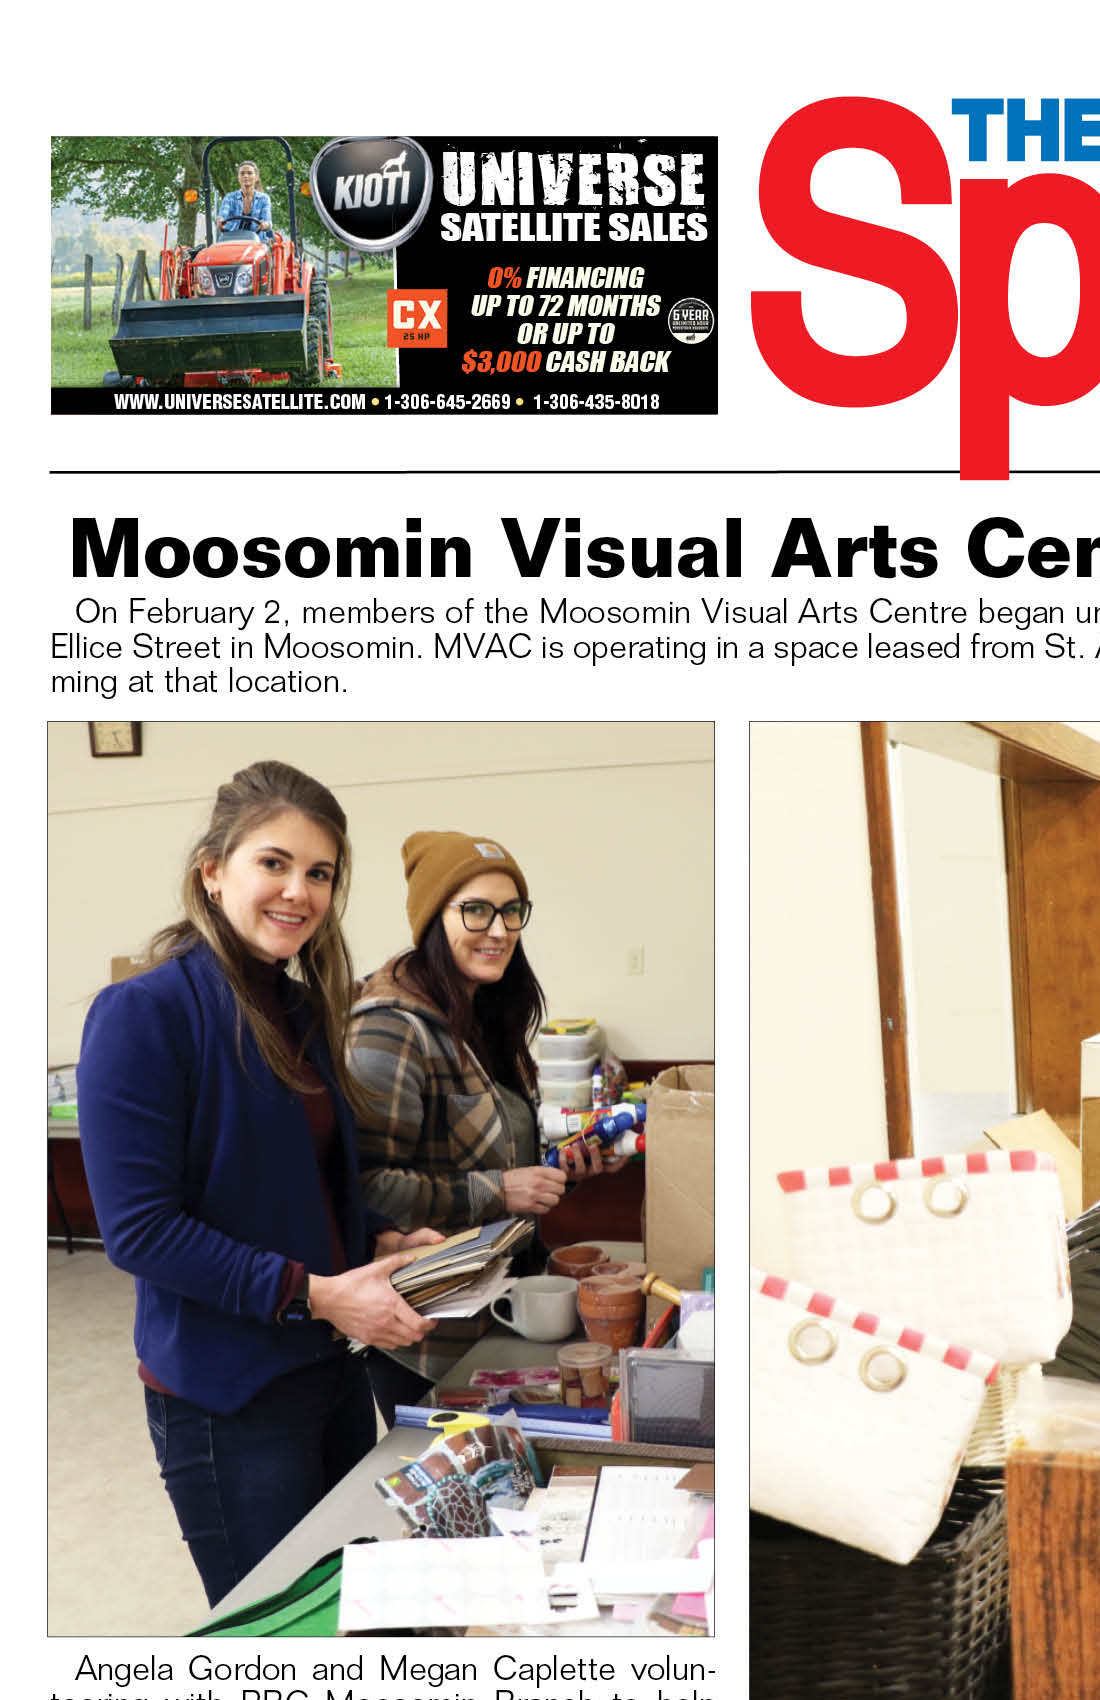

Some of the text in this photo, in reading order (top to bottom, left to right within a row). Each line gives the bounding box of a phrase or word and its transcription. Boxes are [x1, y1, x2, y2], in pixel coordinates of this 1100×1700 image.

[333, 170, 411, 211] KIOTI
[442, 151, 704, 207] UNIVERSE
[441, 213, 707, 241] SATELLITE SALES
[488, 267, 645, 288] 0% FINANCING
[394, 301, 441, 329] CX
[471, 295, 502, 316] UP
[507, 295, 534, 316] TO
[538, 295, 564, 316] 72
[567, 295, 661, 316] MONTHS
[682, 309, 709, 321] YEAR
[403, 332, 430, 340] 25 HP
[517, 323, 615, 344] OR UP TO
[462, 349, 672, 374] $3,000 CASH BACK
[114, 394, 659, 409] WWW.UNIVERSESATELLITE.COM 1-306-645-2669 1-306-435-8018
[73, 518, 470, 578] Moosomin
[501, 518, 741, 578] Visual
[771, 518, 937, 578] Arts
[76, 598, 116, 623] On
[130, 598, 254, 630] February
[265, 600, 288, 627] 2,
[304, 598, 434, 623] members
[446, 598, 474, 623] of
[484, 598, 528, 623] the
[541, 598, 689, 623] Moosomin
[701, 598, 786, 623] Visual
[798, 598, 857, 623] Arts
[870, 598, 967, 623] Centre
[980, 598, 1063, 630] began
[75, 1655, 715, 1688] Angela Gordon and Megan Caplette volun-
